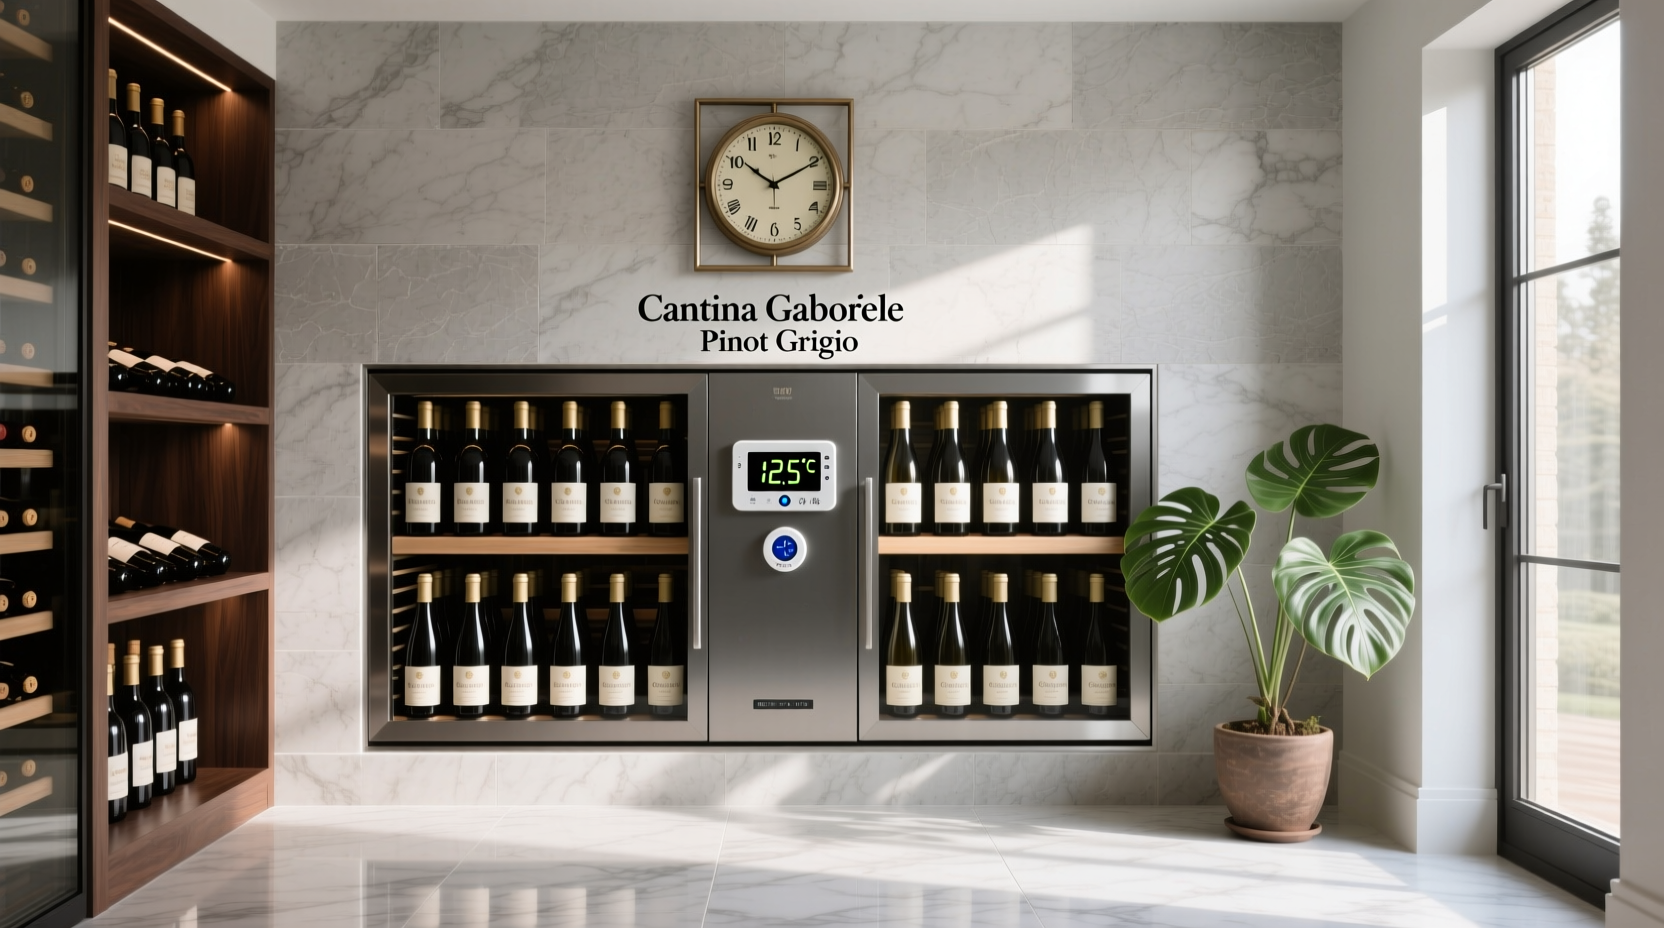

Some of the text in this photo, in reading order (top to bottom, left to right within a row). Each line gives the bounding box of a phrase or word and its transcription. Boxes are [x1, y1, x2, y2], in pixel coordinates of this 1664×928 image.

[747, 136, 757, 152] 11
[768, 131, 782, 146] 12
[730, 155, 744, 169] 10
[808, 155, 820, 168] 2
[722, 178, 734, 191] 9
[770, 222, 780, 237] 6
[793, 217, 802, 231] 5
[638, 294, 757, 322] Cantina
[700, 329, 859, 360] Pinot Grigio
